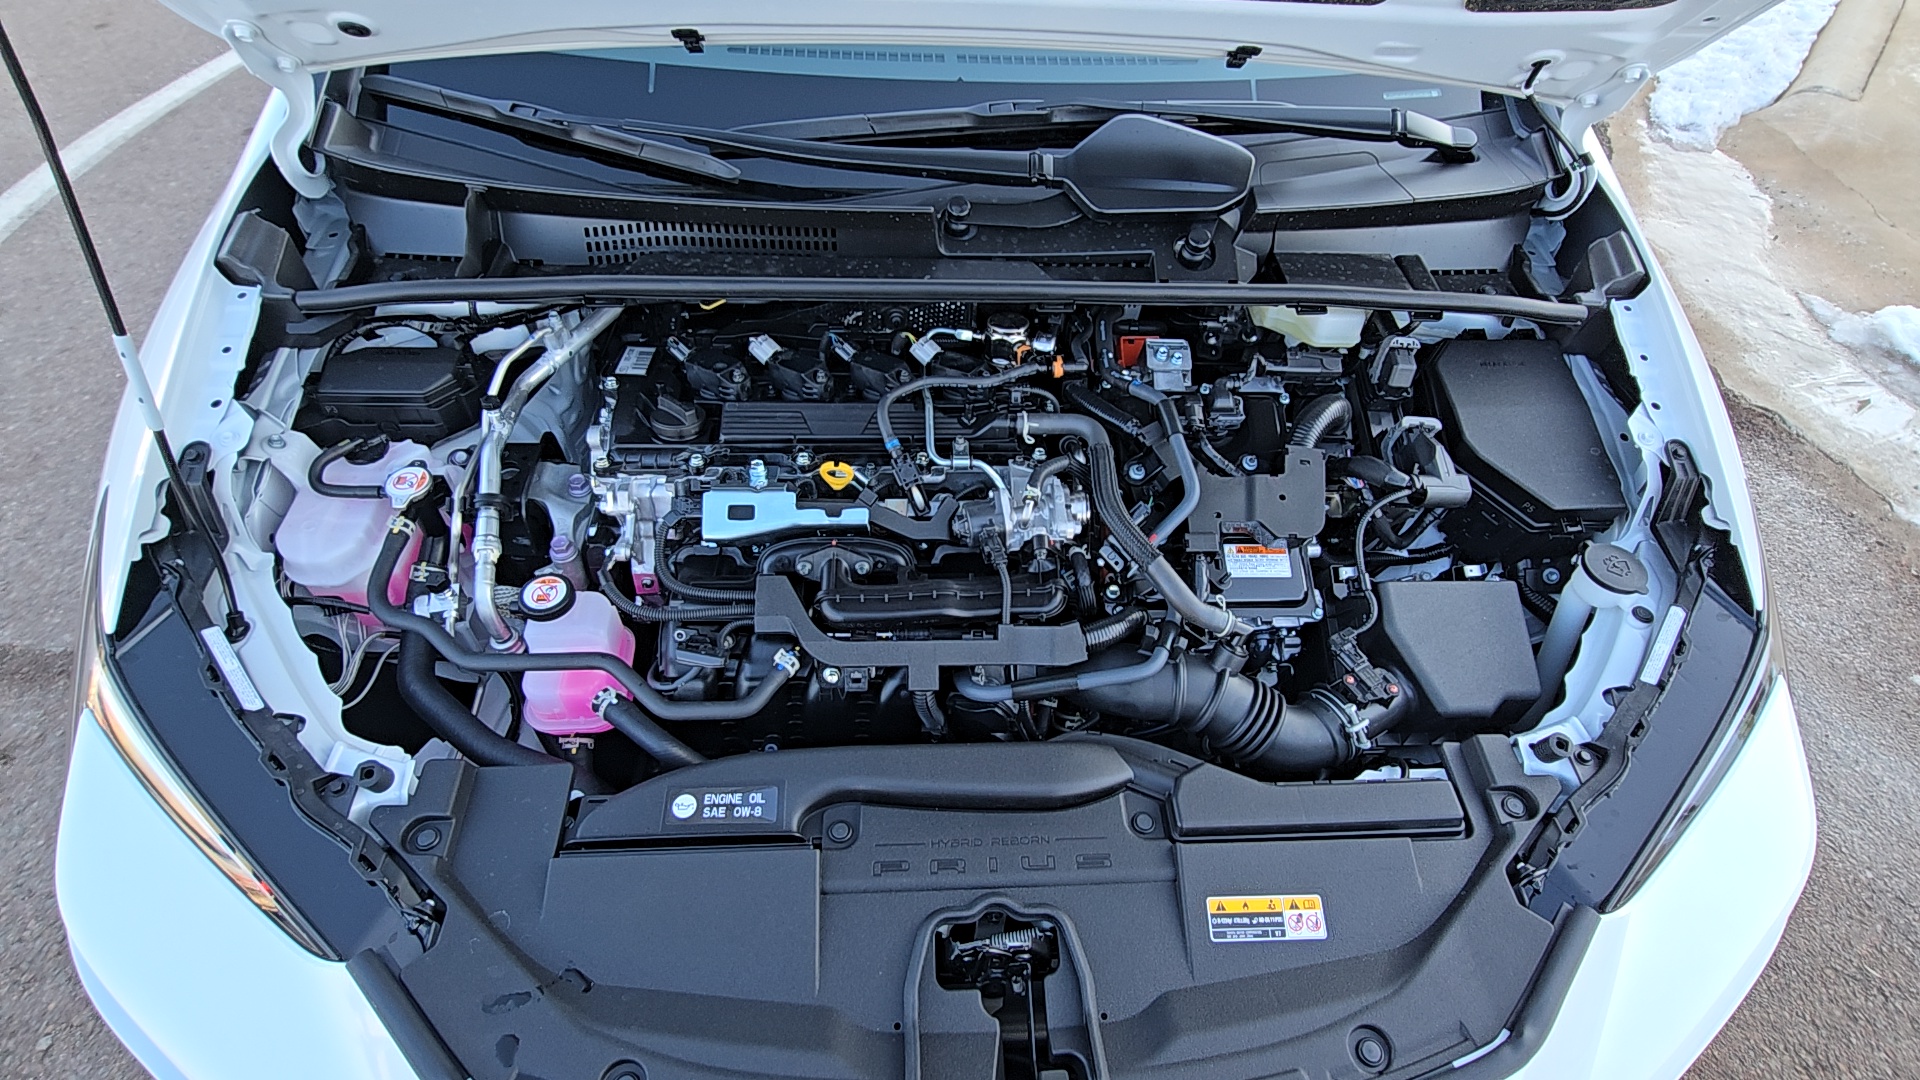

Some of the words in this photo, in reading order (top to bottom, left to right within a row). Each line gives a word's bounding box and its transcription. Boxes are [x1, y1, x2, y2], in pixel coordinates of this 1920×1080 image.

[1521, 501, 1536, 513] P5
[704, 793, 742, 804] ENGINE
[749, 793, 766, 804] OIL
[702, 806, 726, 818] SAE
[733, 806, 762, 817] 0W-8
[930, 838, 983, 848] HYBRID
[990, 836, 1050, 847] REBORN
[872, 853, 1113, 877] PRIUS
